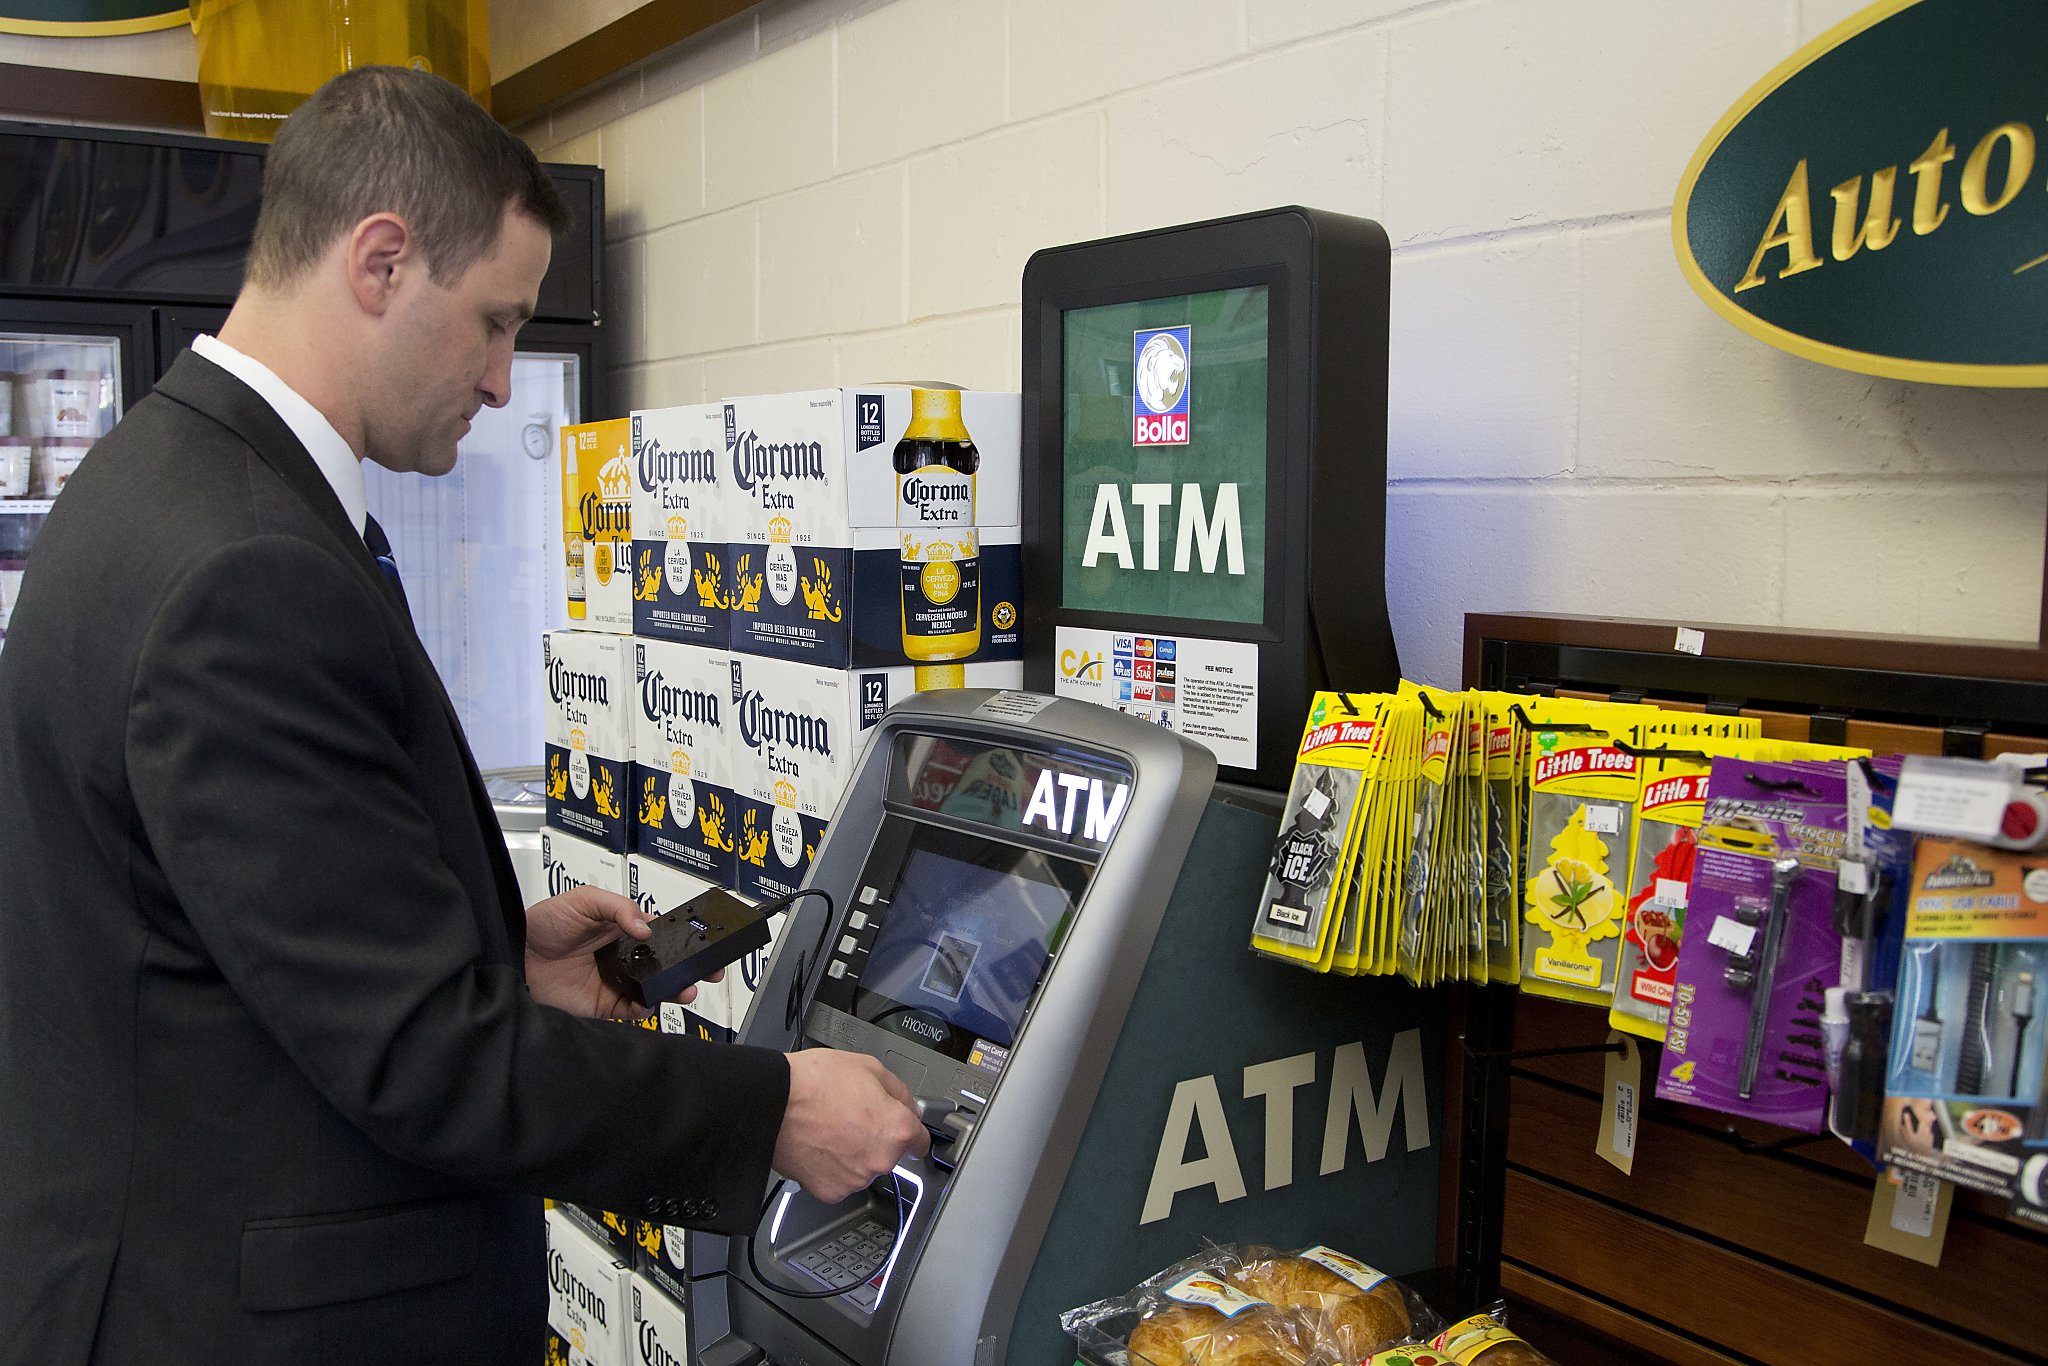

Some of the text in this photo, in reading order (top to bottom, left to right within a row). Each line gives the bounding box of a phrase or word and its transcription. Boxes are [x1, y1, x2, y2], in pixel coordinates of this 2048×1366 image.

[1734, 114, 2048, 293] Auto
[726, 408, 734, 427] 12
[862, 402, 879, 424] 12
[634, 420, 640, 436] 12
[1137, 416, 1186, 442] Bolla
[579, 432, 586, 450] 12
[638, 438, 716, 499] Corona
[733, 428, 825, 498] Corona
[662, 486, 689, 509] Extra
[762, 484, 794, 510] Extra
[902, 478, 969, 508] Corona
[920, 504, 958, 520] Extra
[747, 532, 811, 542] SINCE 1925
[1082, 483, 1245, 574] ATM
[668, 556, 688, 566] CERVEZA
[778, 554, 784, 562] LA
[672, 566, 682, 574] MAS
[770, 563, 793, 572] CERVEZA
[776, 574, 787, 582] MAS
[776, 584, 788, 592] FINA
[653, 610, 670, 620] IMPORTED
[692, 614, 706, 624] MEXICO
[916, 610, 967, 621] CERVECERIA MODELO
[752, 622, 816, 638] IMPORTED BEER FROM MEXICO
[932, 621, 951, 629] MEXICO
[1116, 638, 1132, 649] VISA
[638, 648, 644, 664] 12
[1060, 649, 1105, 680] CAI
[733, 664, 740, 682] 12
[1118, 668, 1131, 676] PLUS
[1136, 670, 1151, 680] STAR
[1157, 668, 1174, 677] pulse
[549, 657, 608, 710] Corona
[866, 682, 882, 701] 12
[1135, 686, 1152, 696] NYCE
[642, 670, 720, 729] Corona
[566, 702, 587, 725] Extra
[739, 690, 831, 757] Corona
[666, 720, 693, 747] Extra
[1302, 722, 1375, 752] Little Trees
[1629, 725, 1639, 745] 1
[653, 758, 668, 768] SINCE
[768, 746, 799, 778] Extra
[1537, 748, 1634, 780] Little Trees
[672, 789, 691, 801] CERVEZA
[753, 788, 817, 813] SINCE 1925
[1644, 778, 1690, 808] Little
[676, 800, 687, 808] MAS
[676, 808, 686, 816] FINA
[1022, 769, 1128, 842] ATM
[783, 816, 789, 825] LA
[775, 824, 799, 838] CERVEZA
[544, 838, 550, 853] 12
[781, 835, 793, 845] MAS
[1290, 841, 1314, 856] BLACK
[657, 836, 674, 850] IMPORTED
[674, 842, 684, 853] BEER
[696, 849, 710, 862] MEXICO
[782, 845, 793, 855] FINA
[630, 866, 637, 883] 12
[1282, 855, 1311, 881] iCE
[759, 876, 779, 892] IMPORTED
[780, 883, 791, 894] BEER
[1950, 896, 1974, 911] USB
[1977, 894, 2018, 910] CABLE
[1276, 908, 1290, 919] Black
[1548, 958, 1590, 972] Vanillaroma
[1641, 982, 1656, 994] Wild
[669, 1007, 674, 1015] LA
[1670, 983, 1696, 1053] 10-50 PSI
[662, 1012, 682, 1028] CERVEZA
[902, 1015, 944, 1042] HYOSUNG
[976, 1040, 1003, 1057] Smart Card
[1670, 1061, 1696, 1083] 4
[1140, 1028, 1431, 1225] ATM
[671, 1239, 680, 1250] MAS
[549, 1249, 607, 1328] Corona
[633, 1290, 640, 1307] 12
[567, 1299, 587, 1332] Extra
